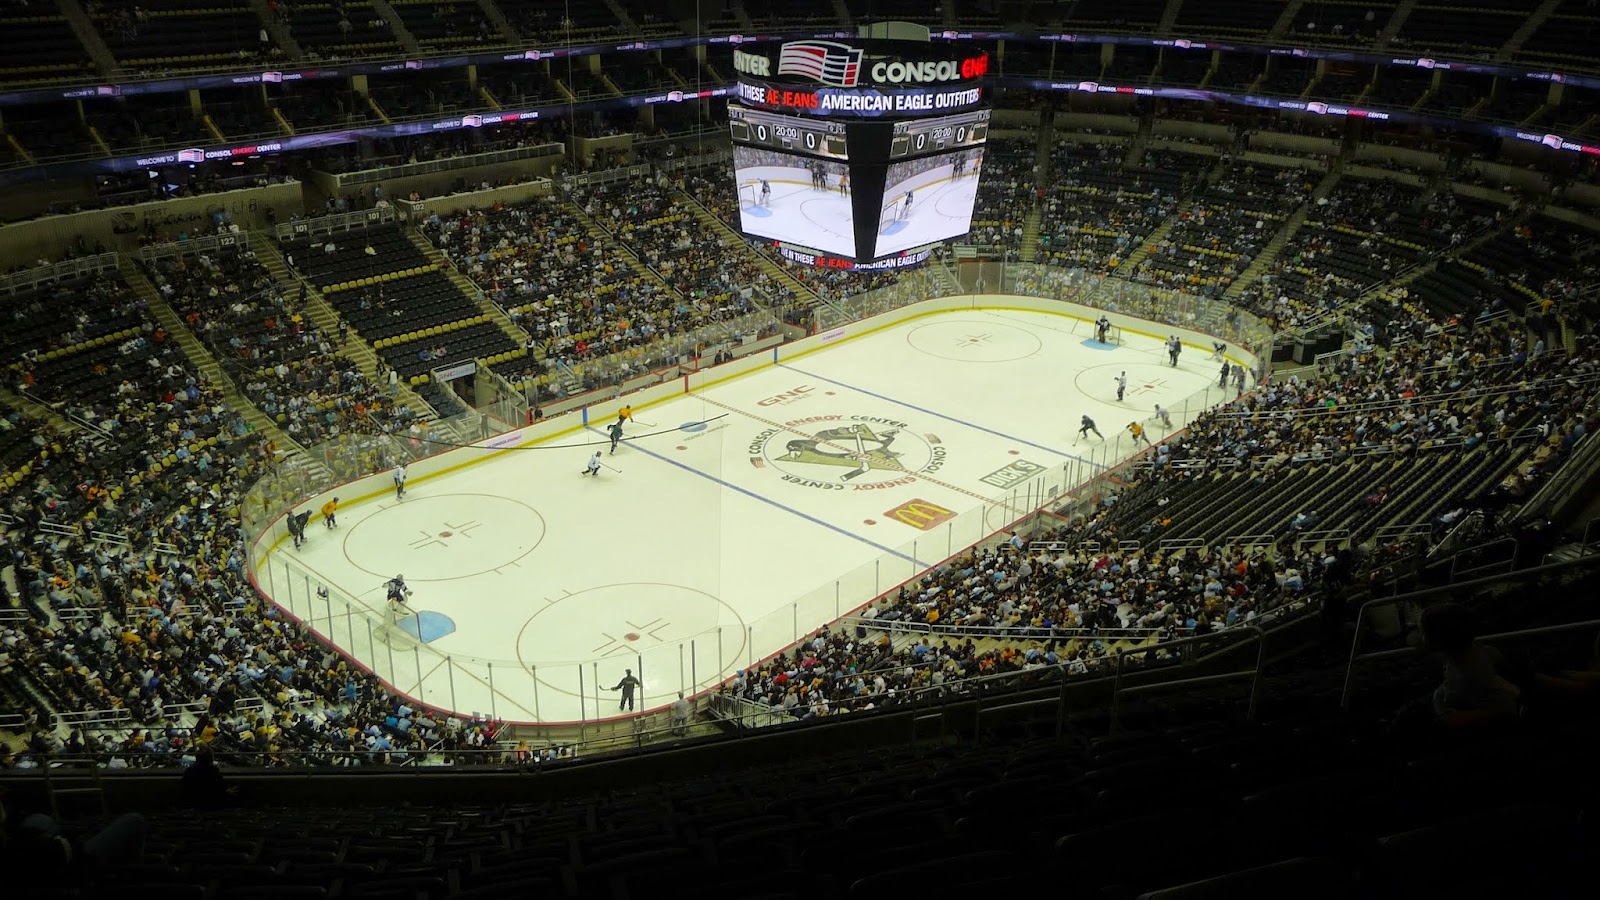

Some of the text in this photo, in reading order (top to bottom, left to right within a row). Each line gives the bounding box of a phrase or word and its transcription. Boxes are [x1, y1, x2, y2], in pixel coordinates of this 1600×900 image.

[871, 60, 961, 84] CONSOL
[744, 84, 766, 104] THESE
[765, 89, 780, 105] AE
[781, 91, 819, 109] JEANS
[821, 94, 893, 111] AMERICAN
[895, 95, 933, 111] EAGLE
[935, 87, 980, 108] OUTFITTERS
[482, 115, 502, 124] CONSOL
[519, 111, 539, 120] CENTER
[757, 125, 767, 141] 0
[775, 126, 797, 138] 20:00
[933, 127, 952, 139] 20:00
[956, 126, 965, 142] 0
[806, 132, 815, 149] 0
[916, 133, 925, 149] 0
[136, 143, 281, 166] WELCOME TO CONSOL ENERGY CENTER
[630, 168, 640, 176] 103
[578, 177, 588, 185] 103
[412, 203, 425, 212] 102
[368, 212, 380, 220] 101
[295, 224, 308, 233] 101
[220, 237, 235, 246] 122
[794, 252, 815, 266] THESE
[815, 256, 826, 267] AE
[828, 257, 854, 269] JEANS
[897, 253, 917, 267] EAGLE
[757, 384, 816, 407] GNC
[749, 414, 908, 455] CONSOL ENERGY CENTER
[780, 446, 947, 491] CONSOL ENERGY CENTER
